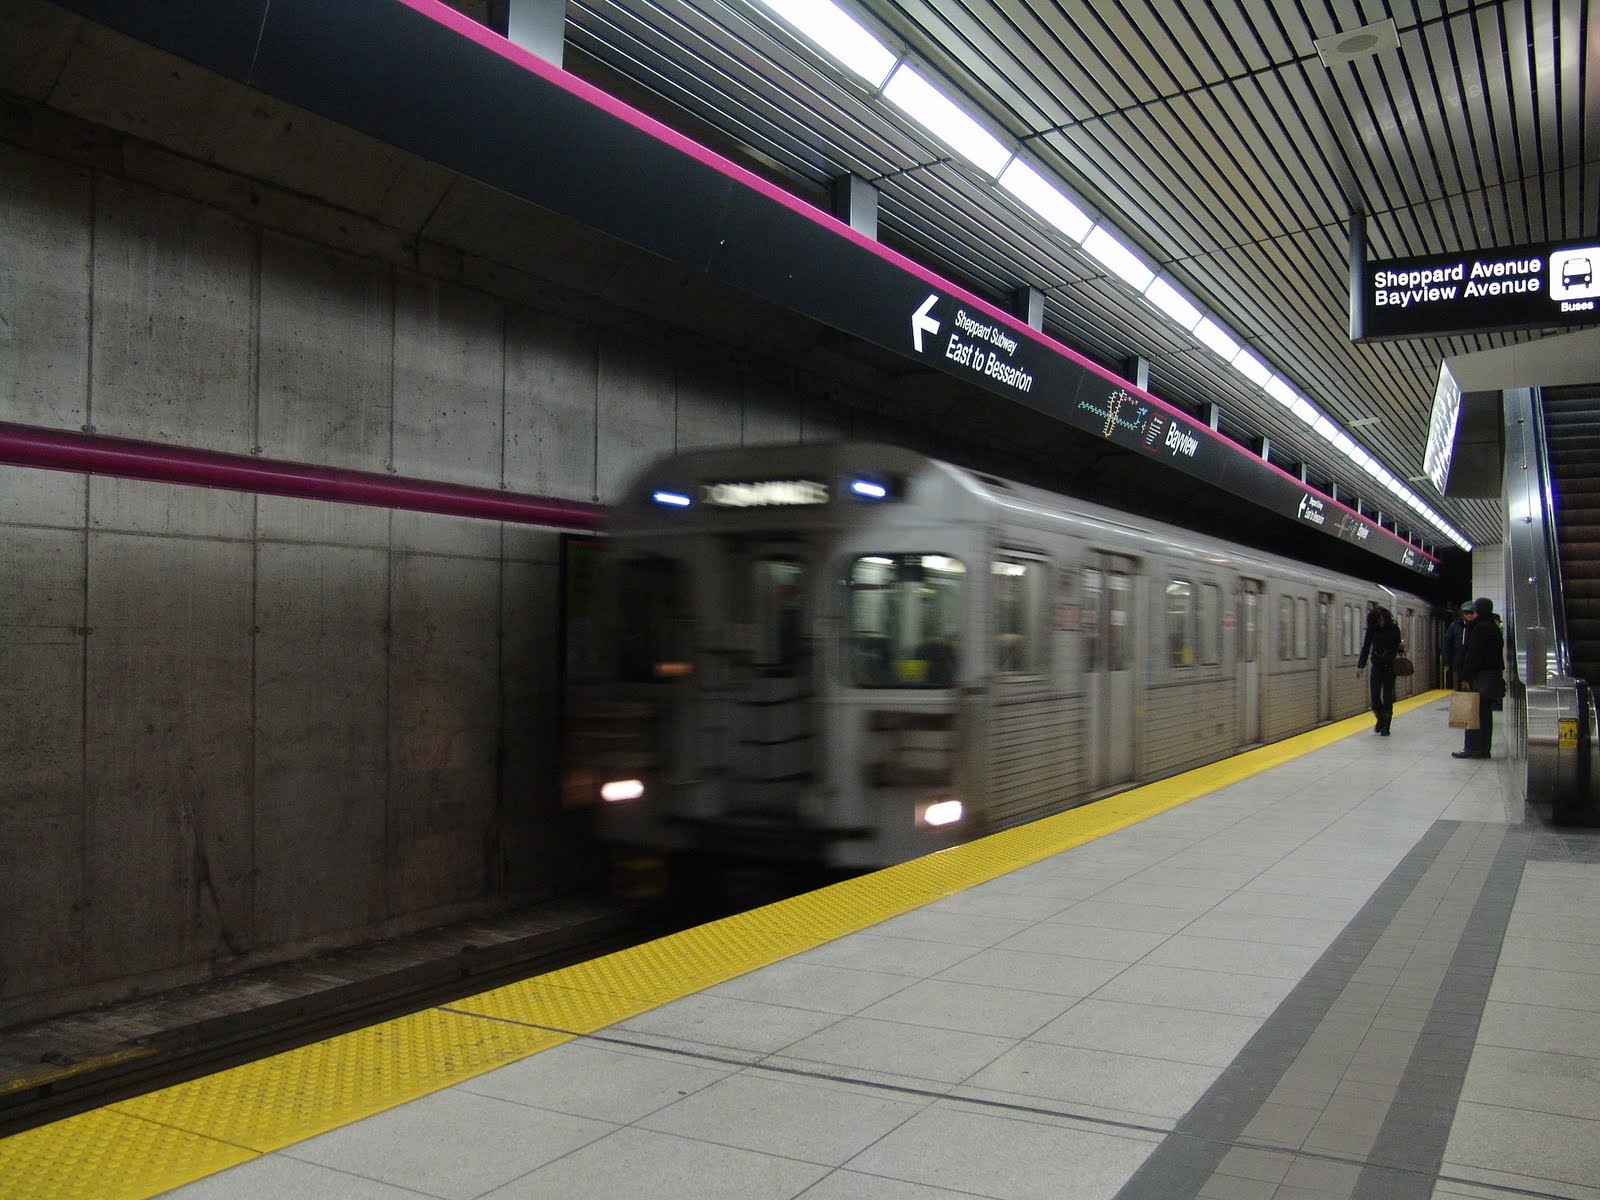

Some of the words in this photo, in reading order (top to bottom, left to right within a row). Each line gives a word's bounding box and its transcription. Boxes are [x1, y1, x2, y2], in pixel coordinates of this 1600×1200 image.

[1375, 265, 1463, 288] Sheppard
[1470, 259, 1542, 279] Avenue
[1375, 286, 1457, 308] Bayview
[1464, 278, 1540, 298] Avenue
[1561, 301, 1594, 313] Buses
[955, 309, 992, 338] Sheppard
[990, 328, 1018, 356] Subway
[945, 333, 974, 366] East
[971, 347, 985, 372] to
[984, 351, 1033, 393] Bessarion
[1165, 421, 1198, 457] Bayview
